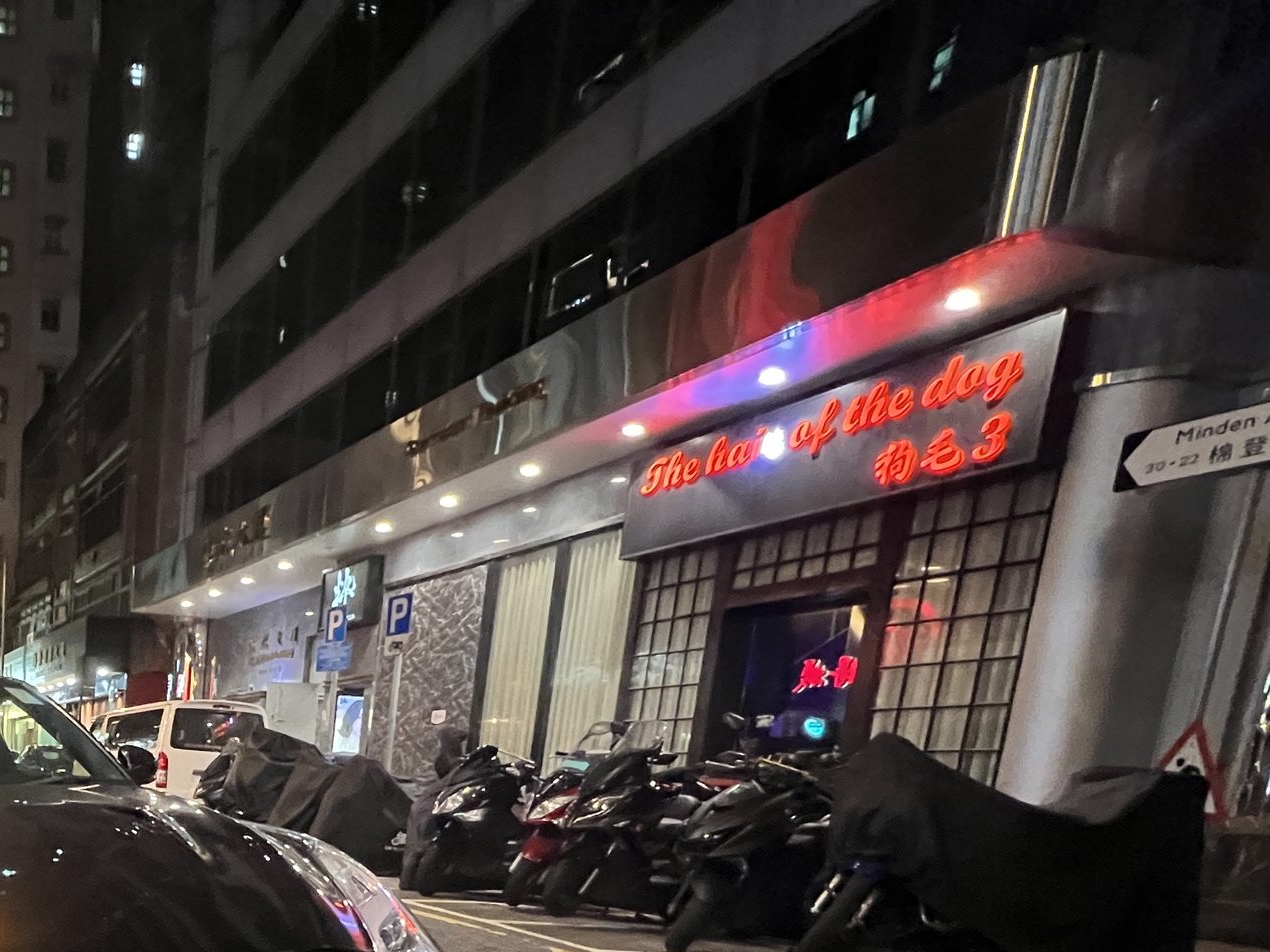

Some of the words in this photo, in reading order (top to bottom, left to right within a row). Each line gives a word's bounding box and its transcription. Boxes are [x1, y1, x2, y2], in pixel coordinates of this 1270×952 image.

[640, 450, 701, 496] The
[705, 426, 785, 477] hai
[789, 397, 841, 456] of
[842, 379, 915, 435] the
[921, 351, 1025, 409] dog
[1175, 416, 1256, 445] Minden
[328, 609, 344, 641] P
[389, 597, 409, 634] P
